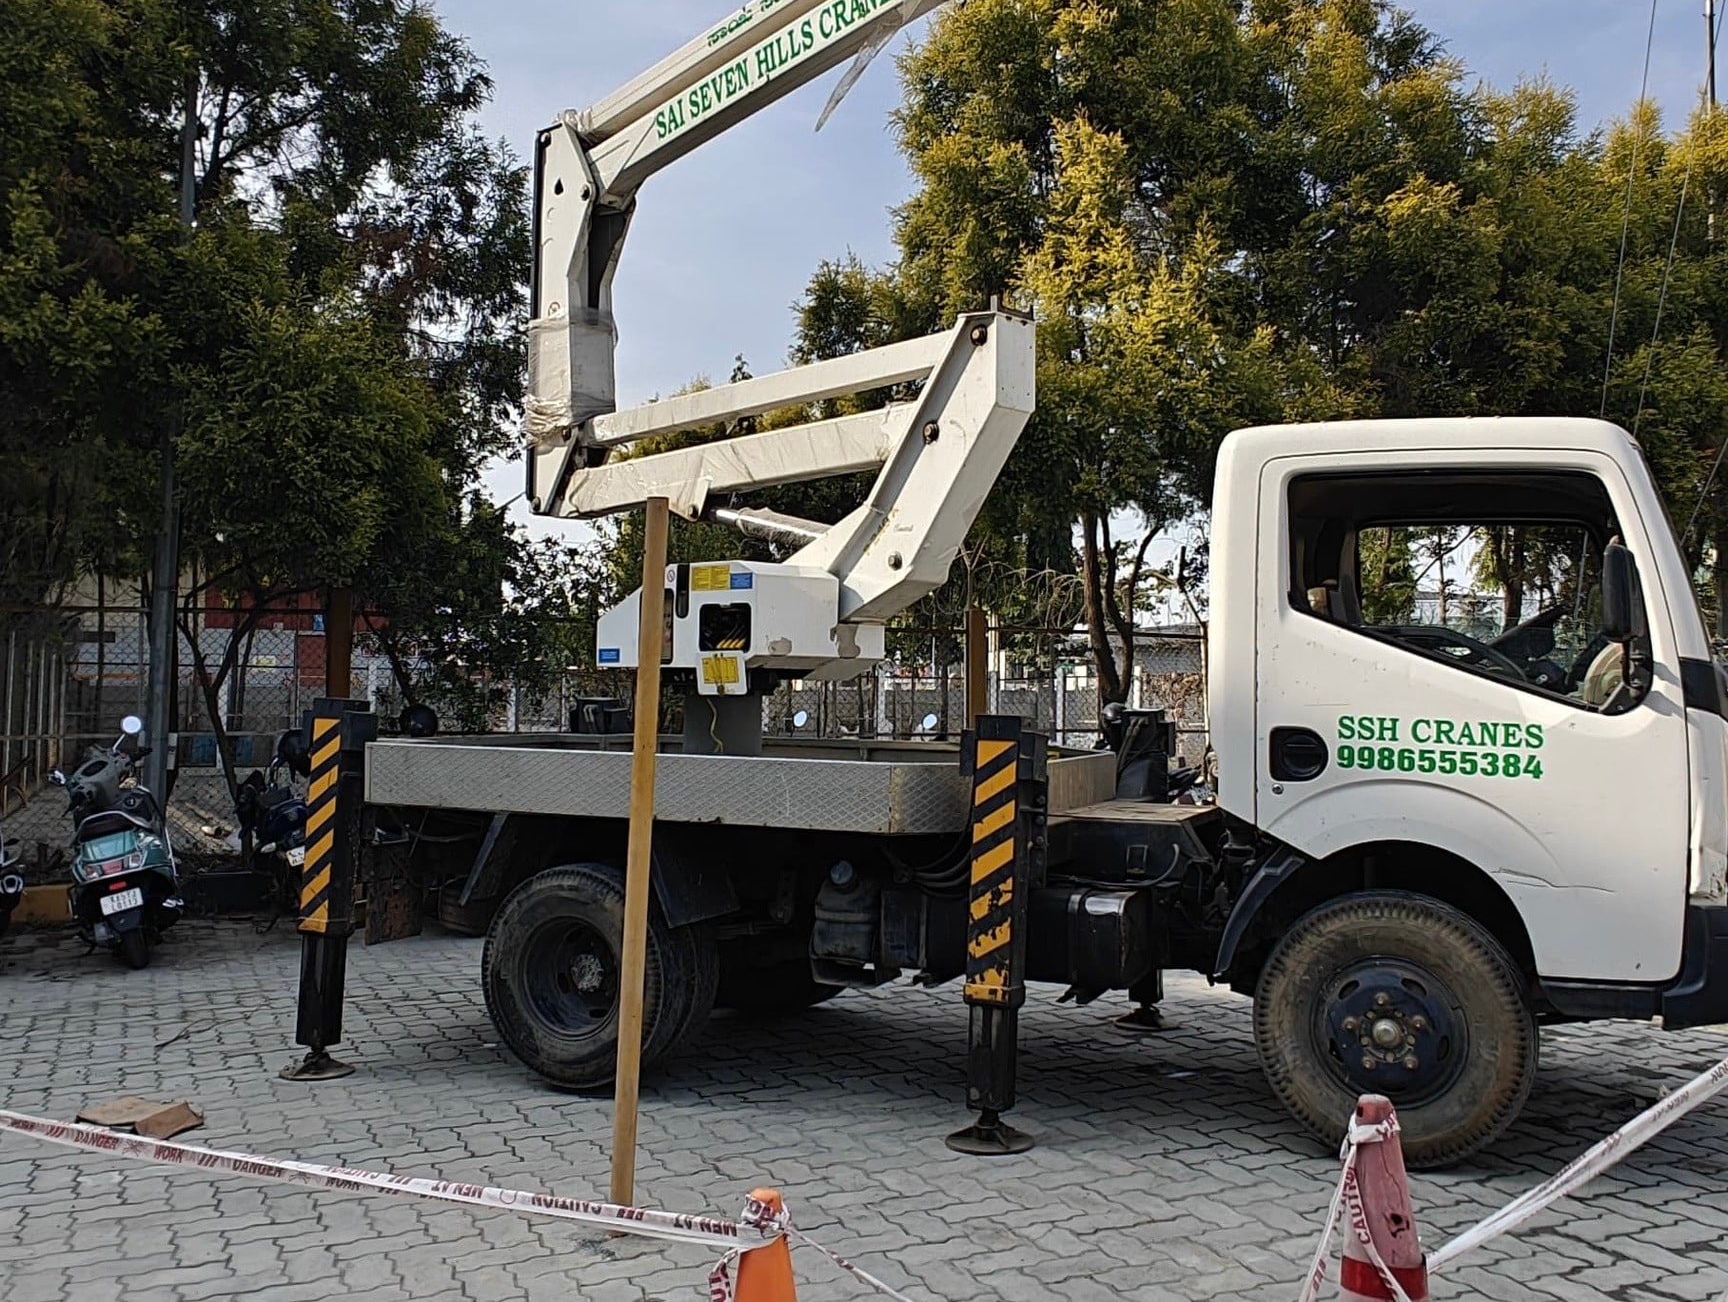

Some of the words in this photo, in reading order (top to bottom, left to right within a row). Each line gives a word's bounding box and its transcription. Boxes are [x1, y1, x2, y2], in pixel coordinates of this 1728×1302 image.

[655, 105, 686, 139] SAI
[688, 59, 750, 118] SEVEN
[754, 19, 815, 79] HILLS
[1337, 715, 1399, 742] SSH
[1410, 718, 1544, 749] CRANES
[1336, 744, 1544, 779] 9986555384
[74, 1129, 119, 1150] DANGER
[153, 1145, 184, 1164] WORK
[231, 1158, 285, 1178] DANGER
